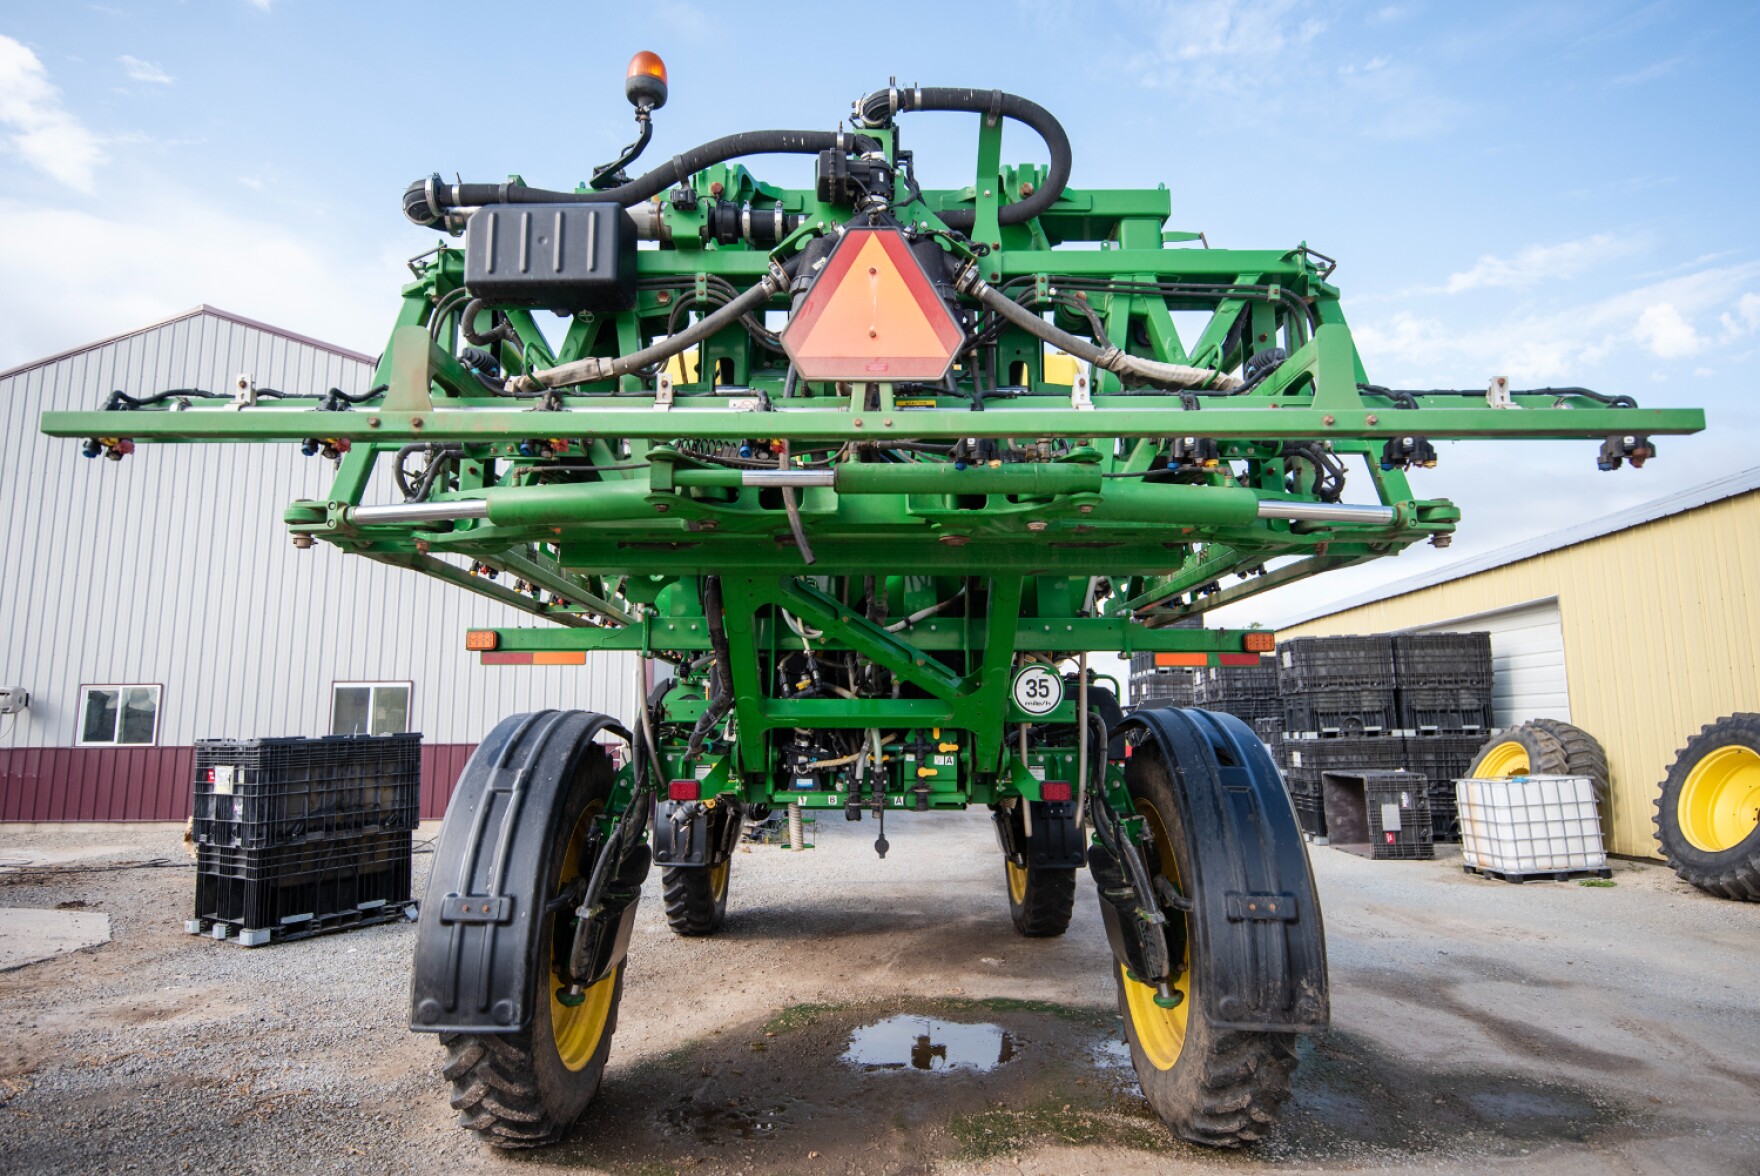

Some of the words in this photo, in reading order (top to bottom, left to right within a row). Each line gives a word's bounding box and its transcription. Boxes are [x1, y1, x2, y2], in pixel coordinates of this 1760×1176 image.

[1025, 678, 1050, 698] 35
[946, 756, 953, 765] A
[896, 796, 902, 805] A
